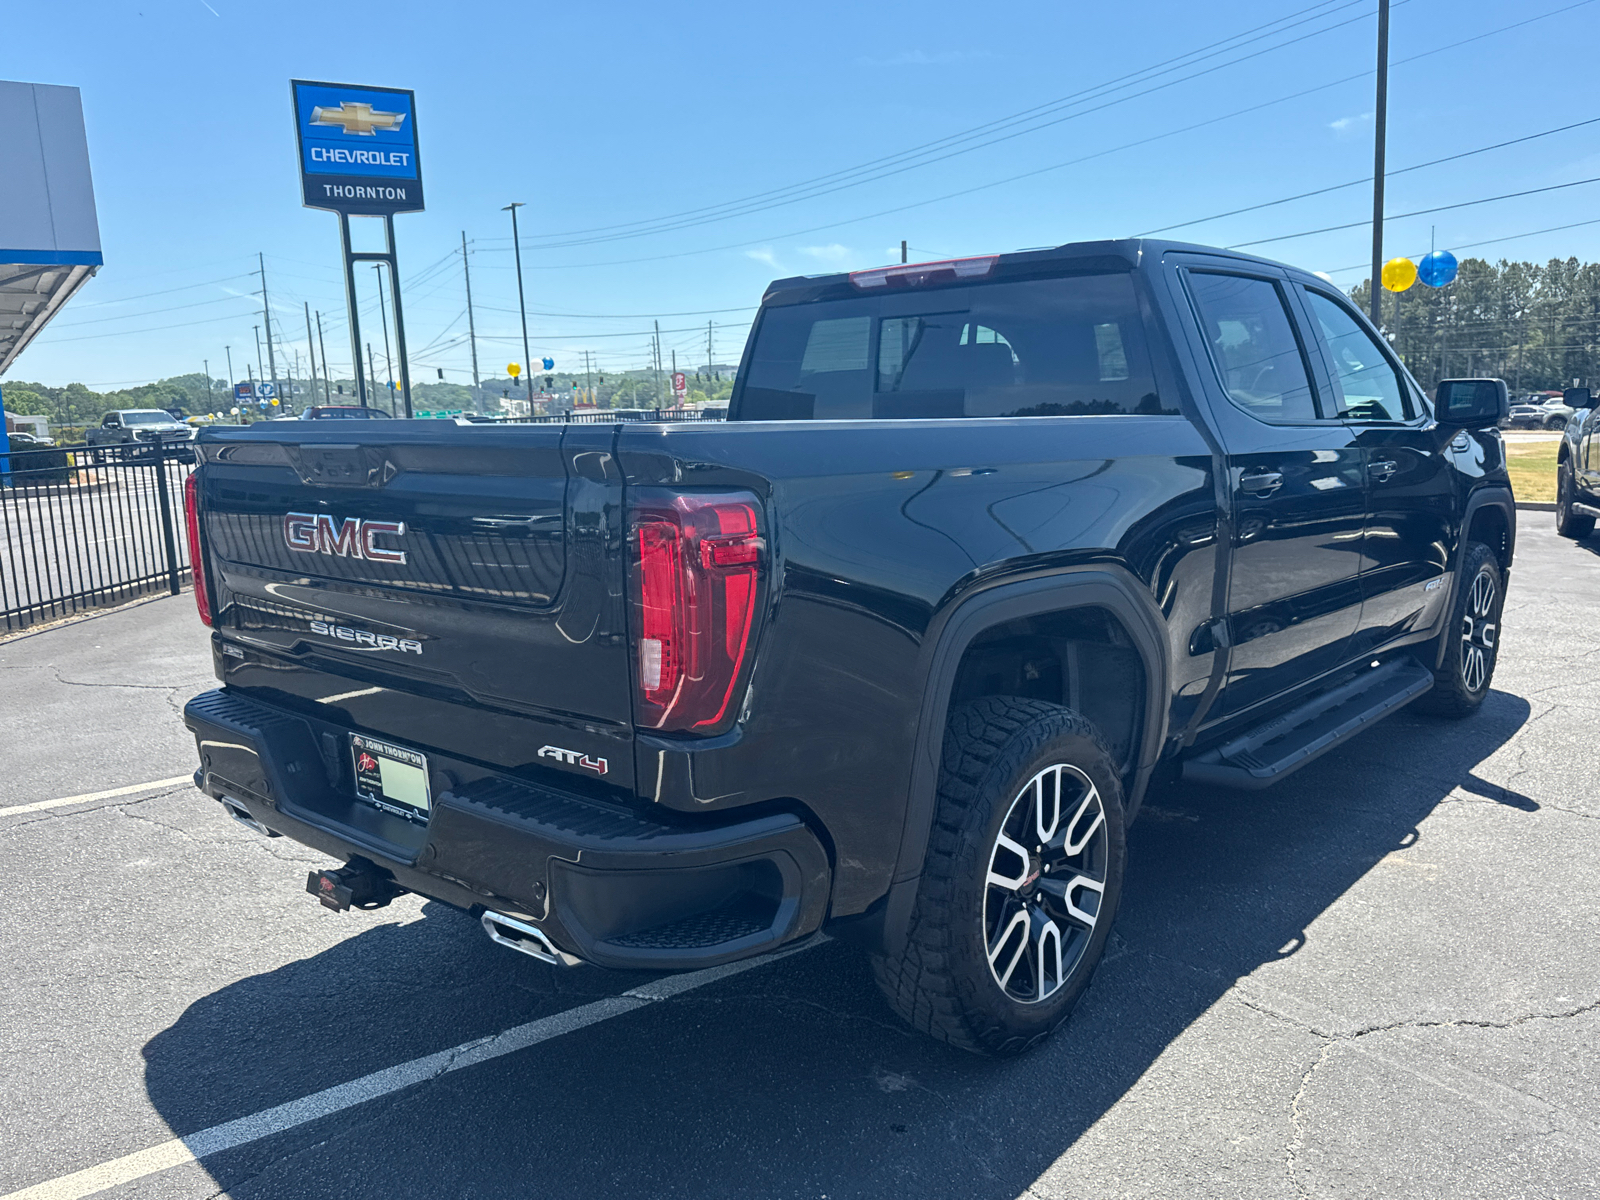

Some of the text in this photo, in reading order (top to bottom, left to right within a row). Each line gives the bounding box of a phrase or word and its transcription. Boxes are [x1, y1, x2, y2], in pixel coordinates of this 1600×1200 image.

[311, 147, 409, 166] CHEVROLET
[323, 184, 406, 200] THORNTON
[284, 511, 407, 565] GMC
[310, 620, 423, 655] SIERRA
[365, 740, 384, 753] JOHN
[384, 745, 422, 765] THORNTON
[537, 745, 609, 775] AT4
